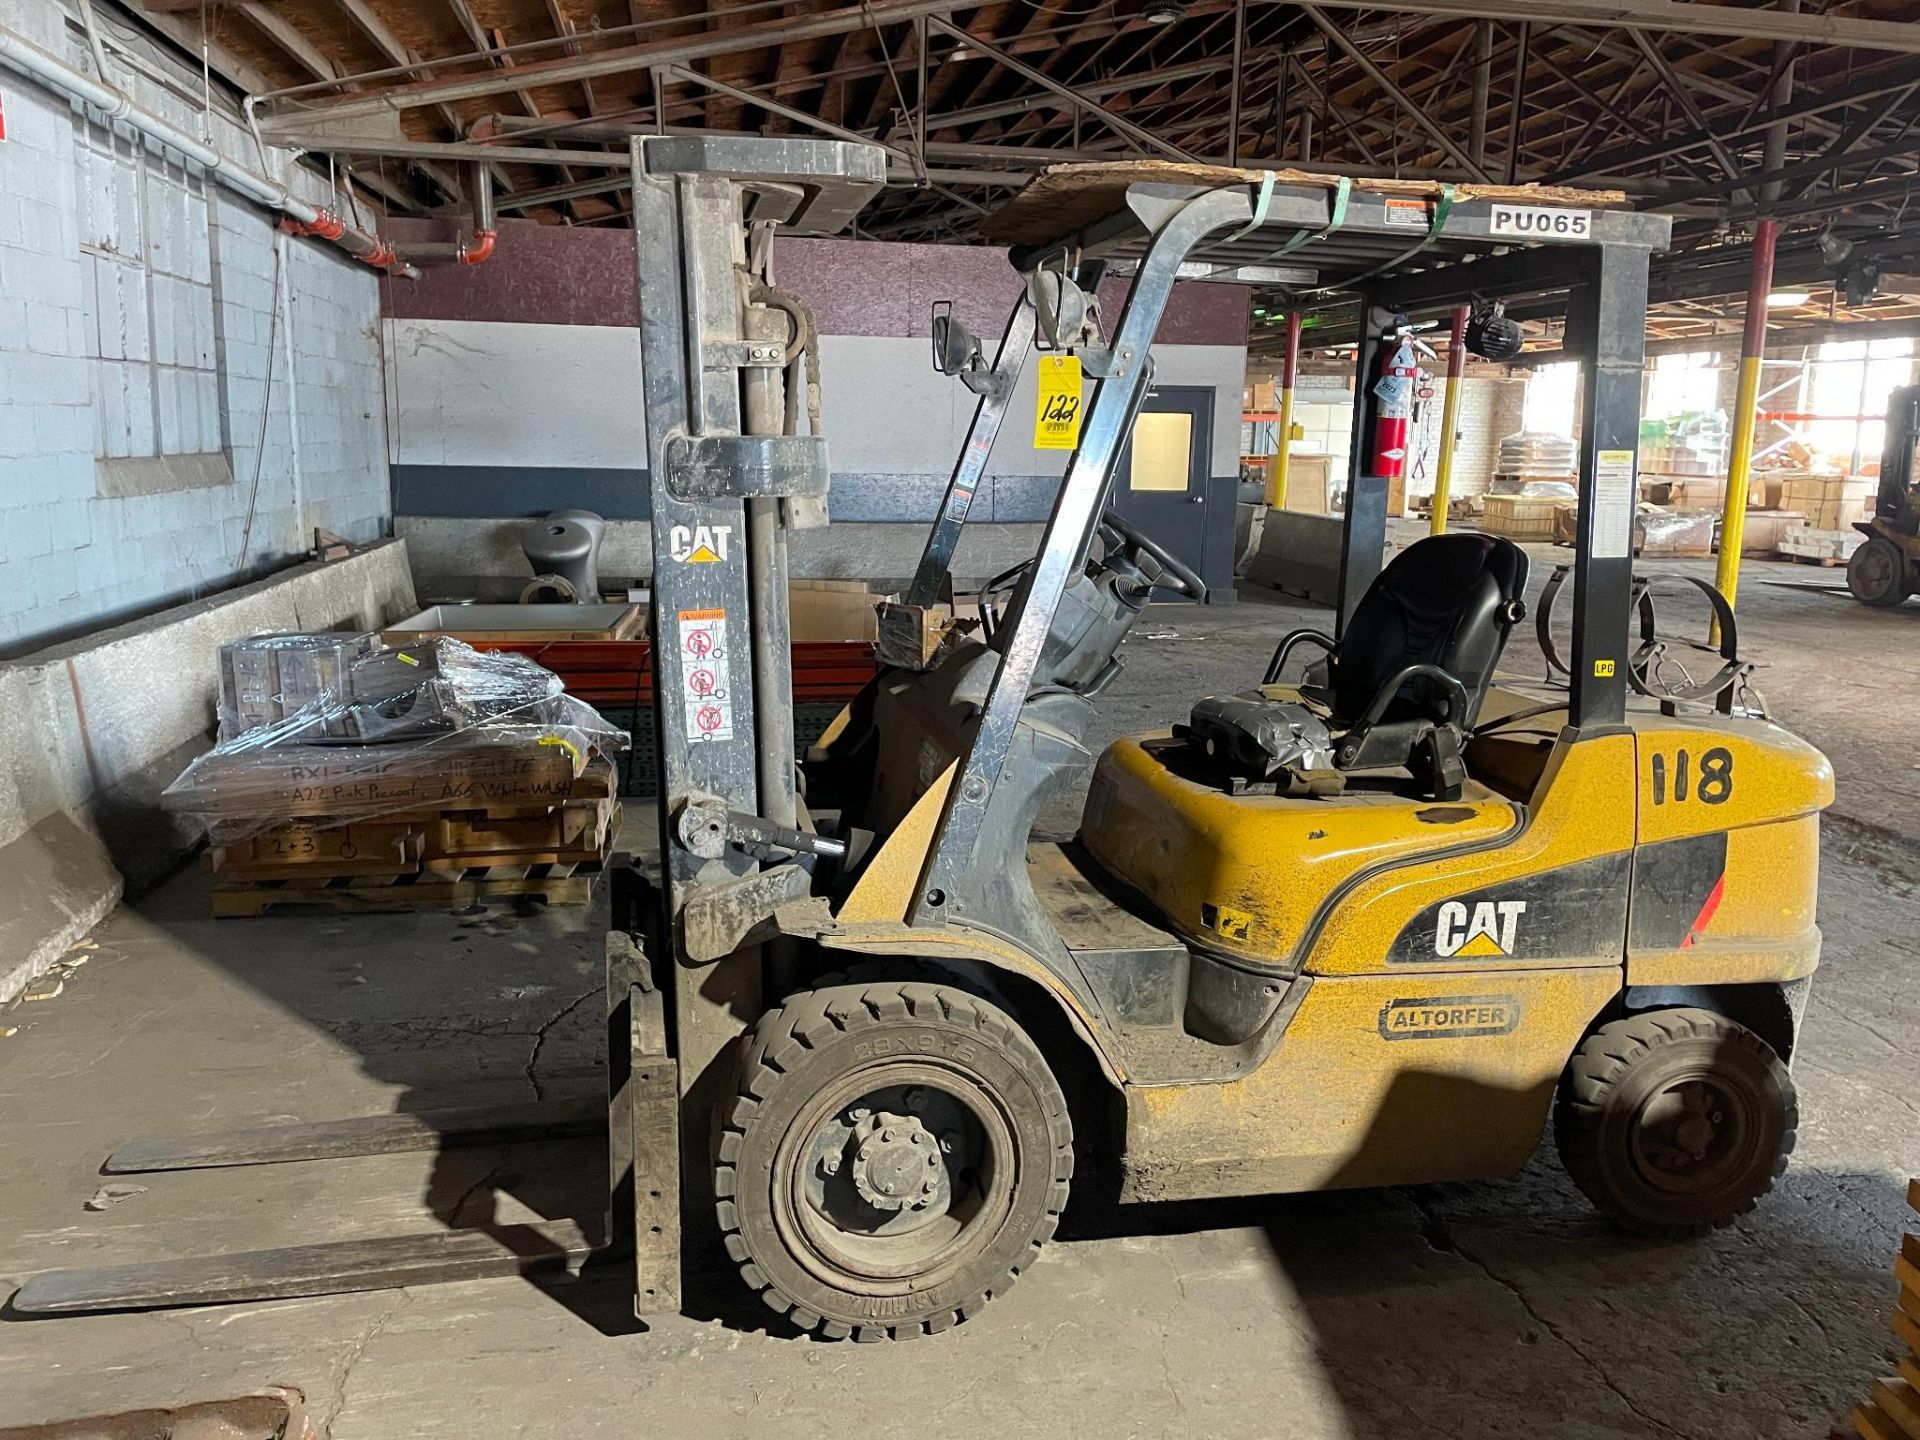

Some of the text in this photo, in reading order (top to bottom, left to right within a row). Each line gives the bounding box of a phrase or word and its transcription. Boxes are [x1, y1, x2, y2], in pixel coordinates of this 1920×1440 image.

[1495, 210, 1588, 234] PU065
[1040, 394, 1080, 422] 122
[670, 525, 732, 563] CAT
[1595, 663, 1614, 674] LPG
[1651, 746, 1734, 805] 118
[291, 786, 329, 803] A22
[272, 838, 287, 854] 2
[302, 836, 314, 853] 3
[1435, 900, 1527, 957] CAT
[1393, 1007, 1506, 1028] ALTORFER
